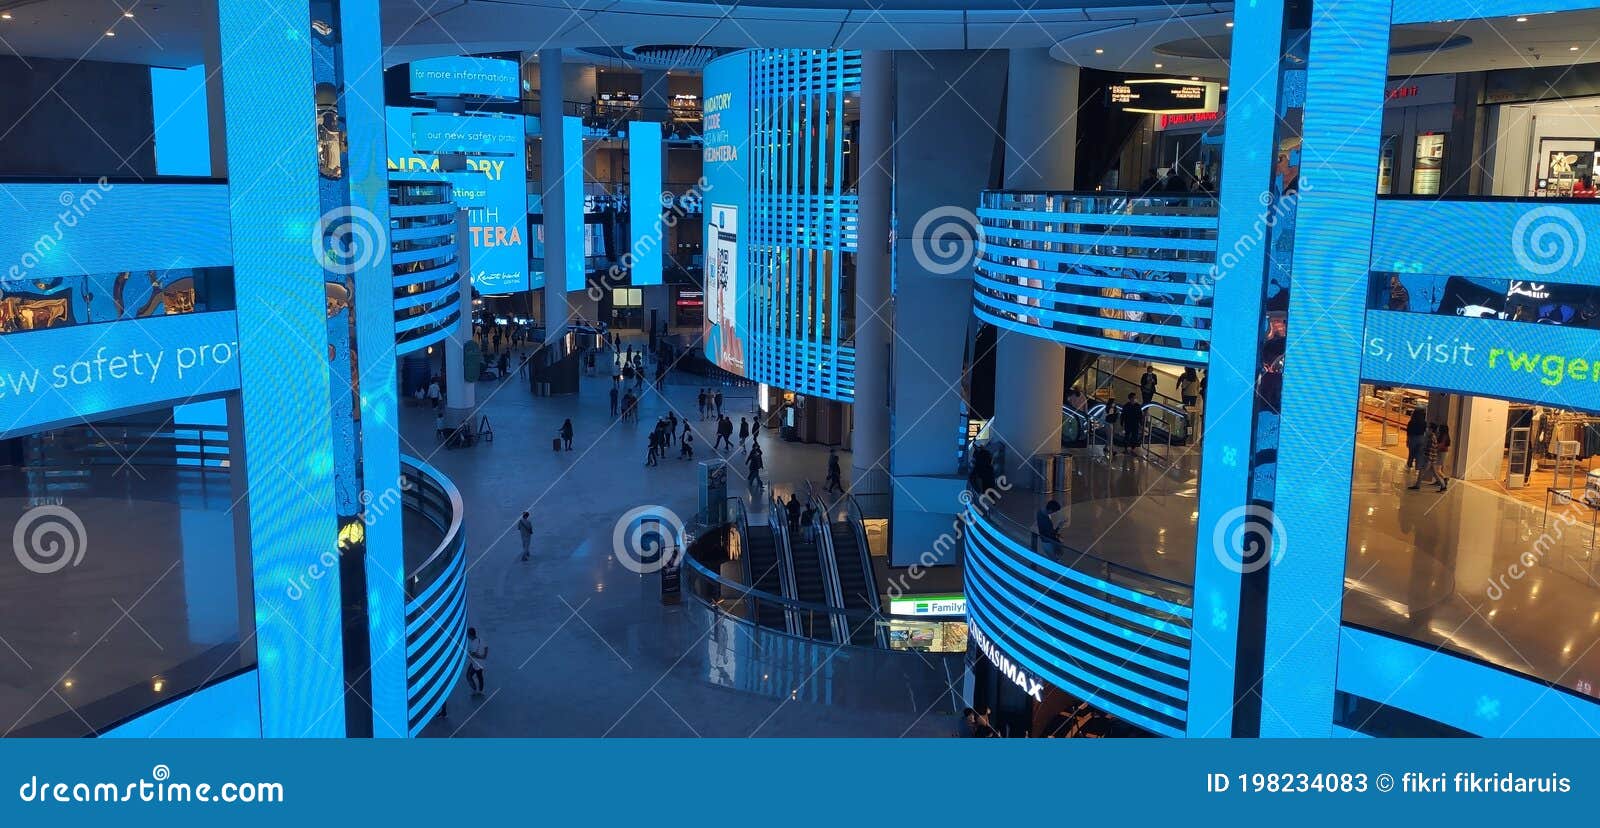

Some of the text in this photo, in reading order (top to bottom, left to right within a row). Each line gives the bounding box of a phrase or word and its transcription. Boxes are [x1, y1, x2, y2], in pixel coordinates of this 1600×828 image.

[427, 71, 450, 79] more
[1169, 111, 1217, 123] PUBLIC BANK
[467, 131, 496, 142] safety
[1406, 335, 1476, 367] visit
[53, 346, 165, 389] safety
[999, 654, 1045, 703] IMAX
